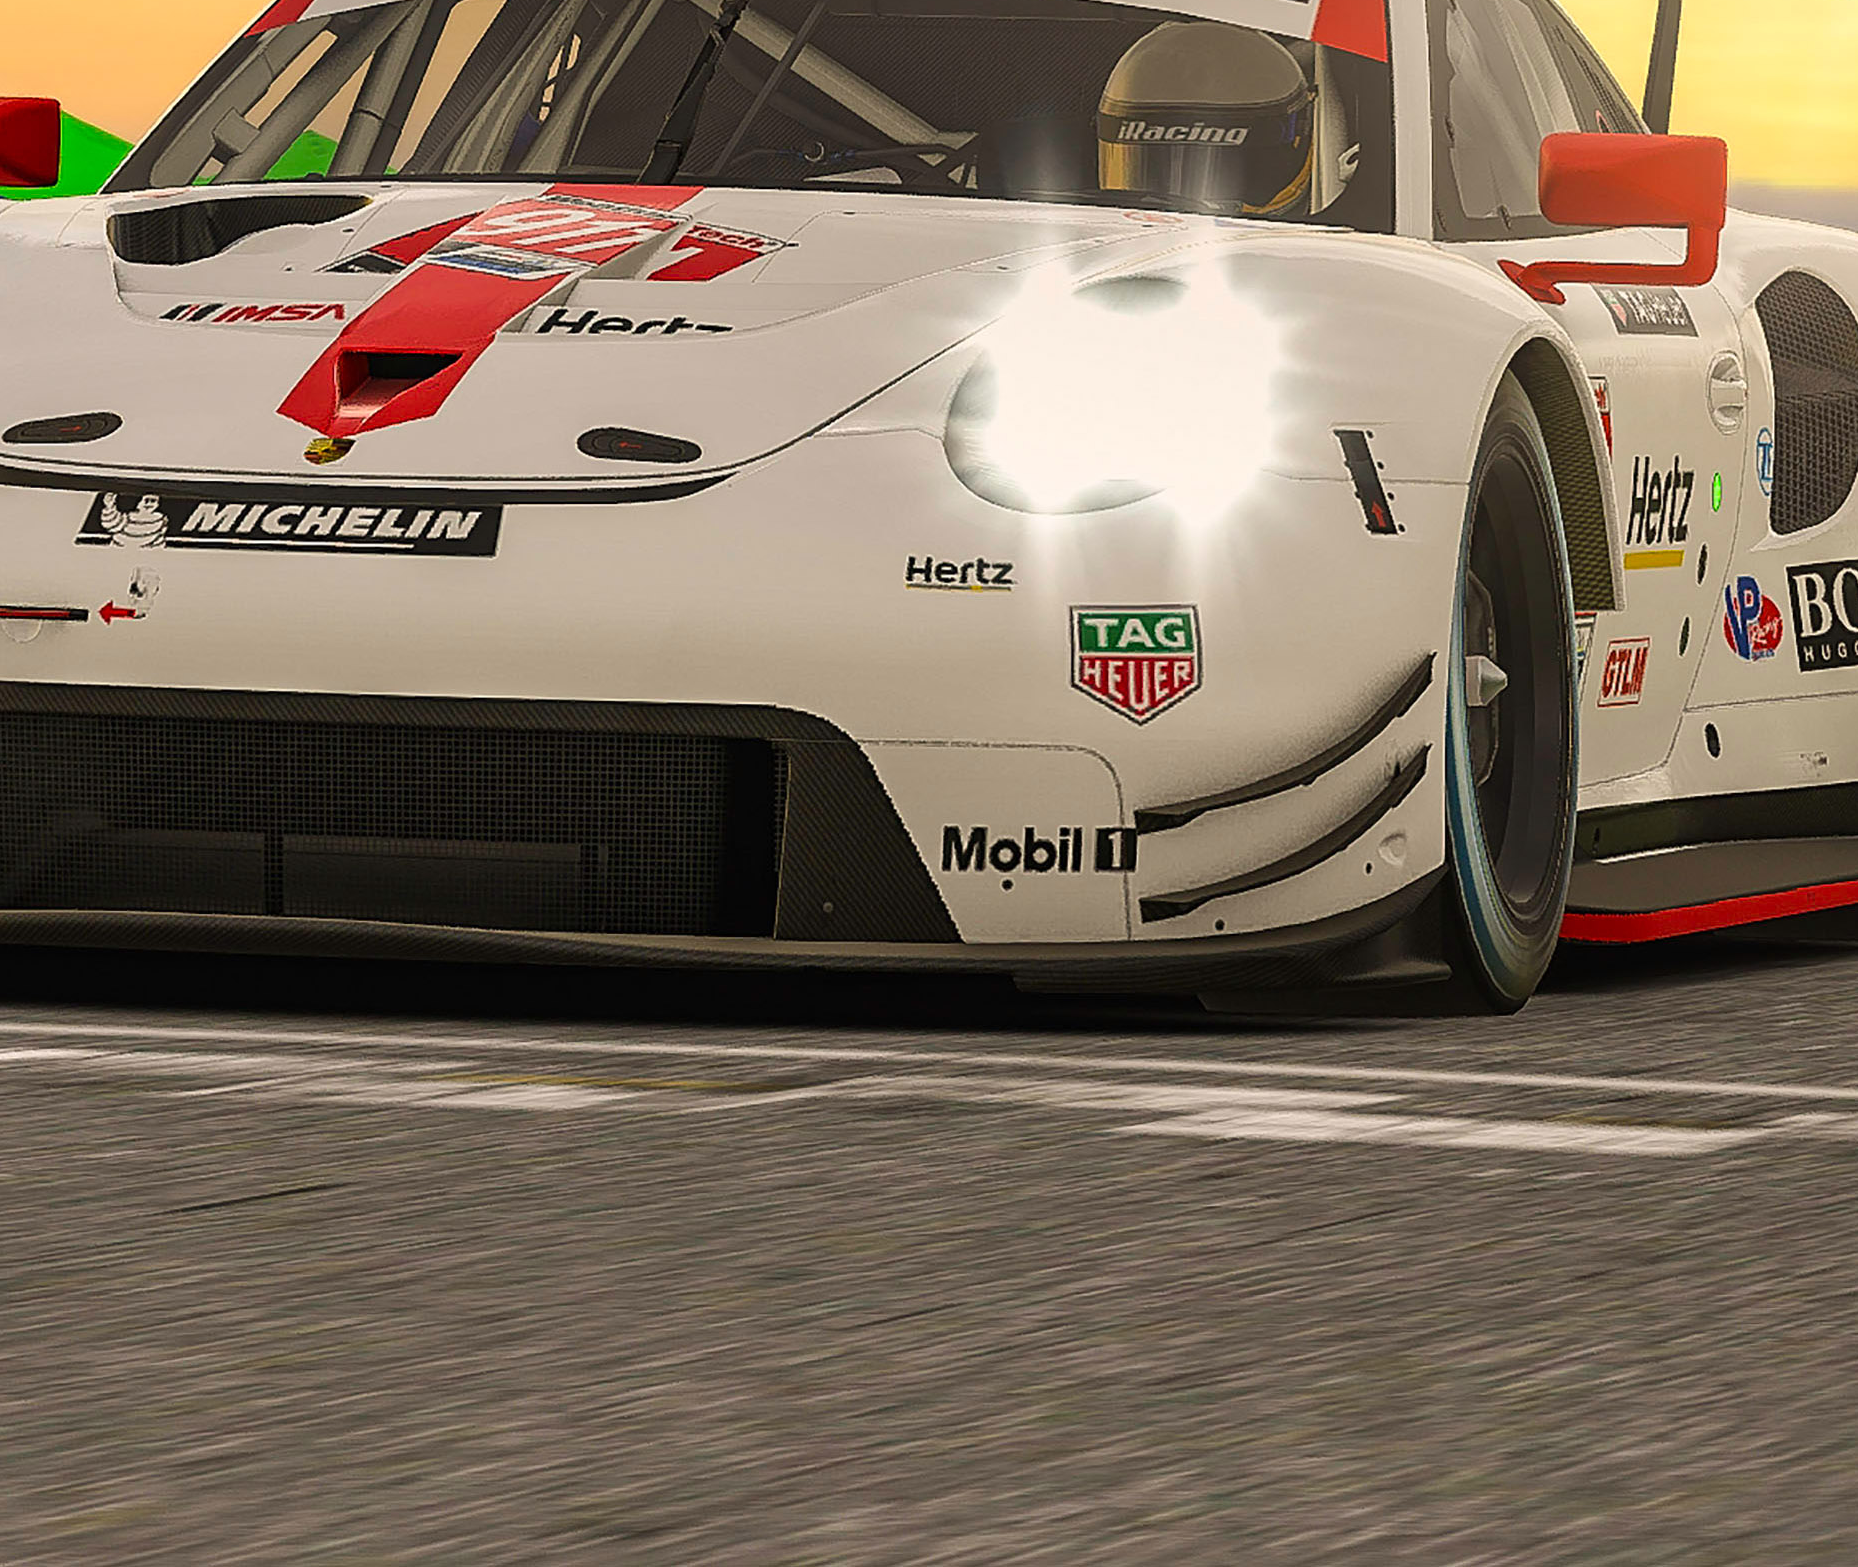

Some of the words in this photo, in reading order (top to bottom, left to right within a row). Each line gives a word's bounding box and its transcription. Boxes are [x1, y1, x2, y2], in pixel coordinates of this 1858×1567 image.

[1118, 120, 1251, 146] iRacing
[210, 303, 345, 324] IMSA
[1625, 455, 1695, 546] Hertz
[185, 502, 483, 540] MICHELIN
[905, 555, 1014, 586] Hertz
[1083, 616, 1187, 650] TAG
[1082, 658, 1193, 711] HEUER
[1602, 646, 1649, 699] GTLM
[941, 824, 1083, 873] Mobil
